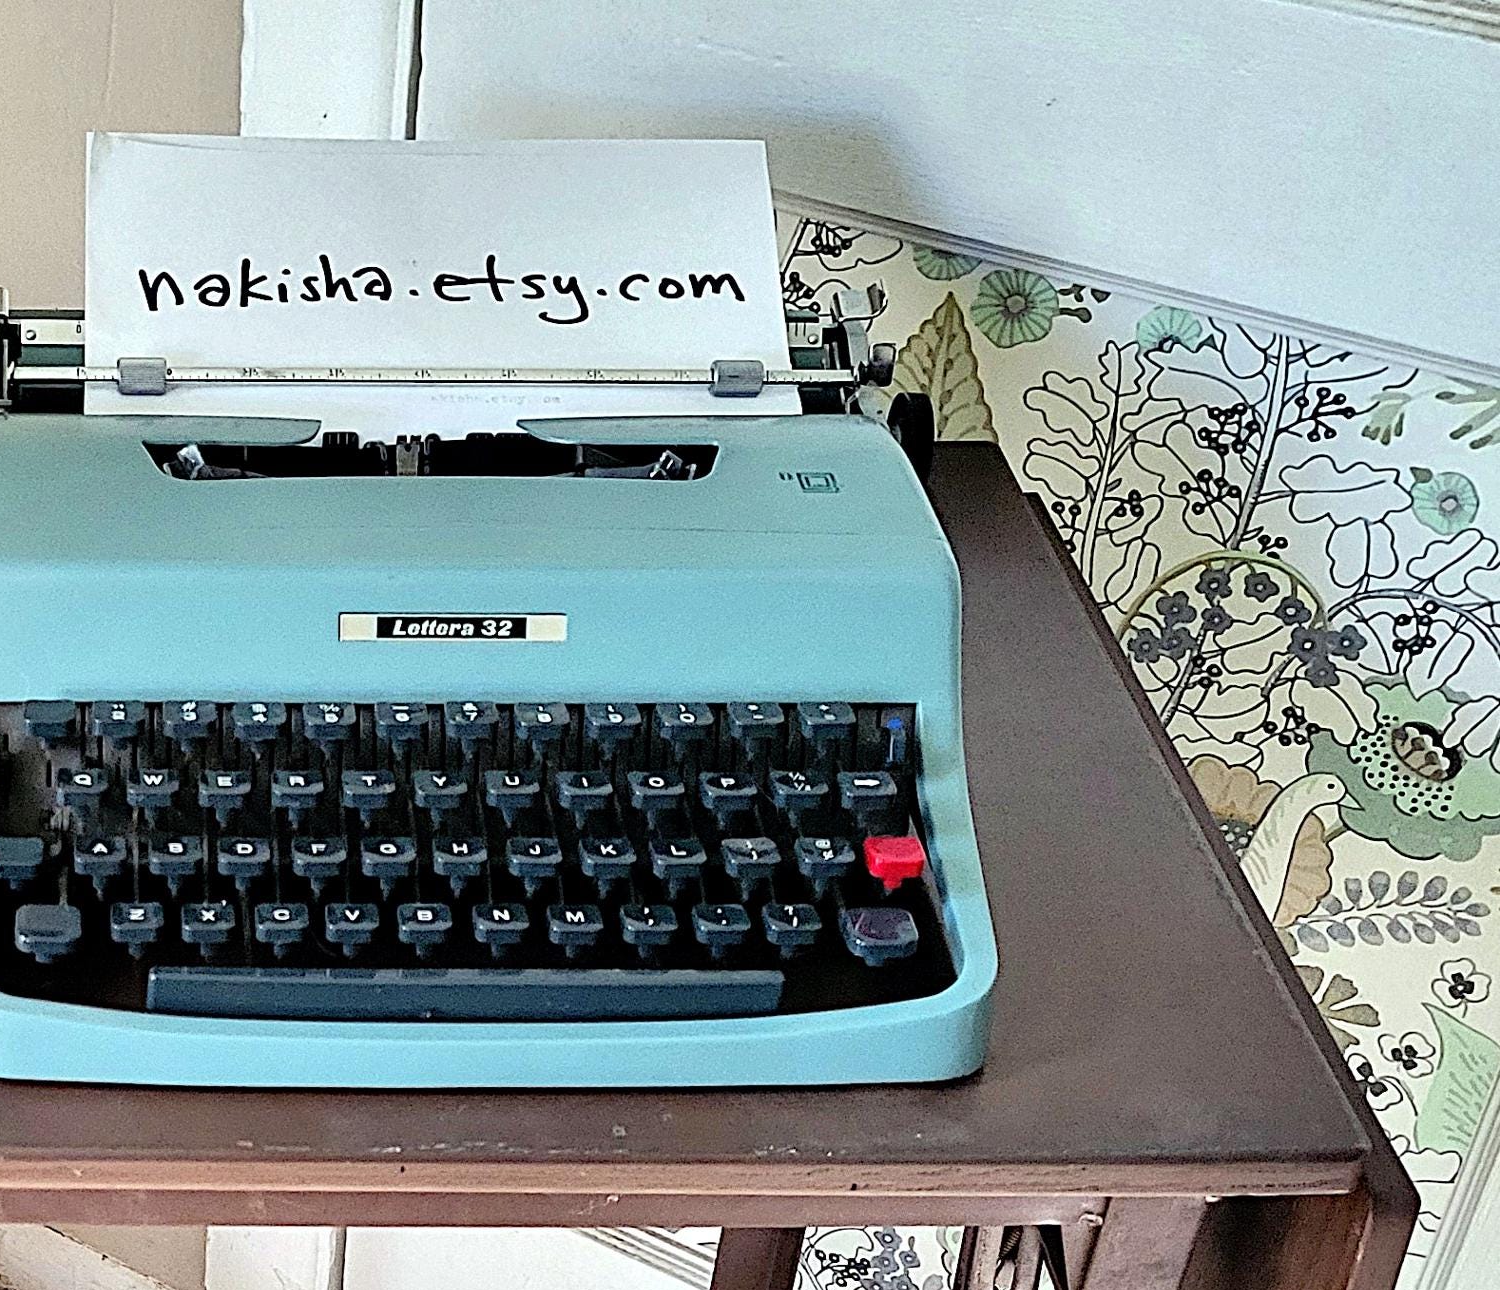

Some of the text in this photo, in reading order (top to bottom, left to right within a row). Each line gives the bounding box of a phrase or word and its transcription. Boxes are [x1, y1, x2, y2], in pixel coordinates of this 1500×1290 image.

[138, 254, 746, 325] nakisha.etsy.com
[480, 619, 513, 636] 32
[143, 774, 164, 786] W
[217, 776, 234, 788] E
[361, 775, 378, 787] T
[433, 776, 448, 788] Y
[505, 777, 521, 787] U
[648, 778, 666, 789] O
[93, 843, 109, 855] A
[236, 844, 255, 855] D
[311, 844, 328, 855] F
[452, 843, 470, 855] H
[529, 844, 542, 856] J
[600, 844, 618, 857] K
[670, 844, 688, 857] L
[130, 909, 147, 922] Z
[201, 910, 217, 922] X
[344, 910, 362, 922] V
[417, 909, 434, 922] B
[492, 910, 512, 922] N
[565, 911, 587, 924] M
